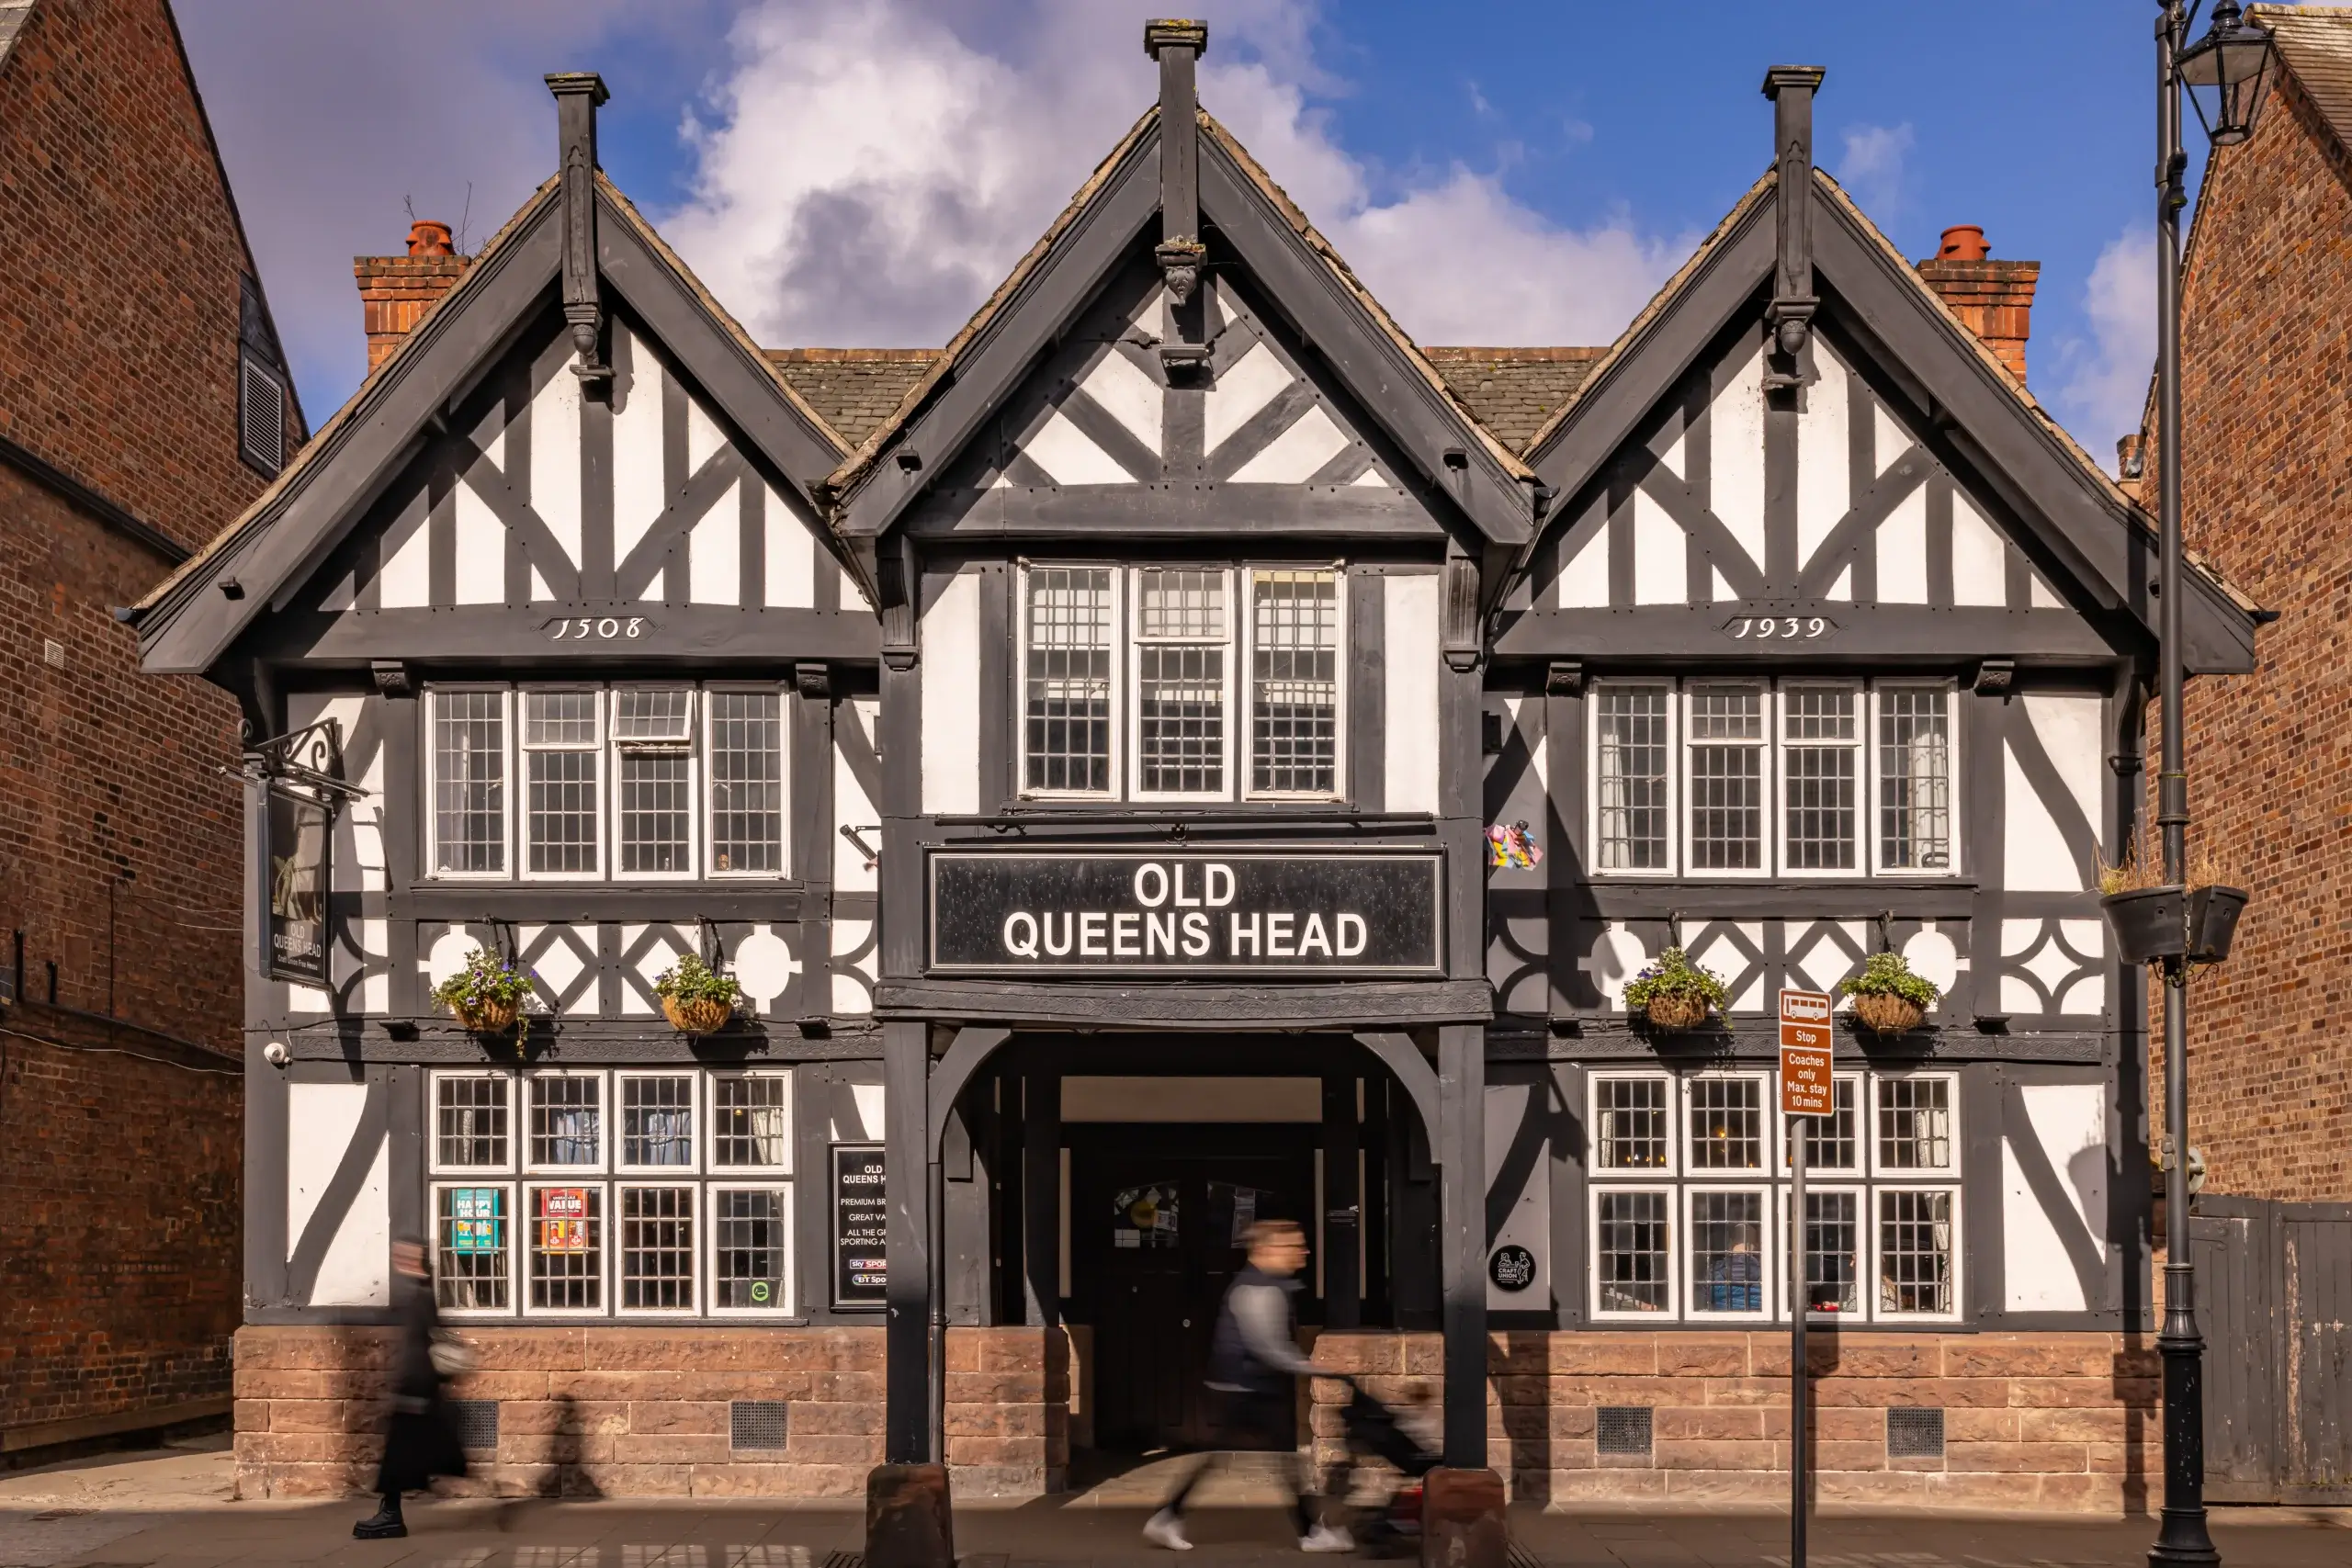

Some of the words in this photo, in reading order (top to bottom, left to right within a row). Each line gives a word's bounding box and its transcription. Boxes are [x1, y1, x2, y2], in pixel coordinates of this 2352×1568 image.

[553, 617, 645, 639] 1508
[1735, 617, 1825, 639] 1939
[1134, 863, 1236, 908] OLD
[291, 923, 304, 938] OLD
[1003, 912, 1211, 959] QUEENS
[1232, 912, 1367, 957] HEAD
[274, 933, 301, 953] QUEENS
[303, 941, 321, 957] HEAD
[1796, 1030, 1816, 1044] Stop
[1789, 1053, 1825, 1066] Coaches
[1798, 1069, 1815, 1082] only
[1787, 1081, 1807, 1093] Max.
[1809, 1084, 1827, 1097] stay
[1792, 1095, 1803, 1107] 10
[1803, 1097, 1823, 1108] mins
[864, 1165, 883, 1174] OLD
[842, 1175, 878, 1184] QUEENS
[841, 1198, 875, 1206] PREMIUM
